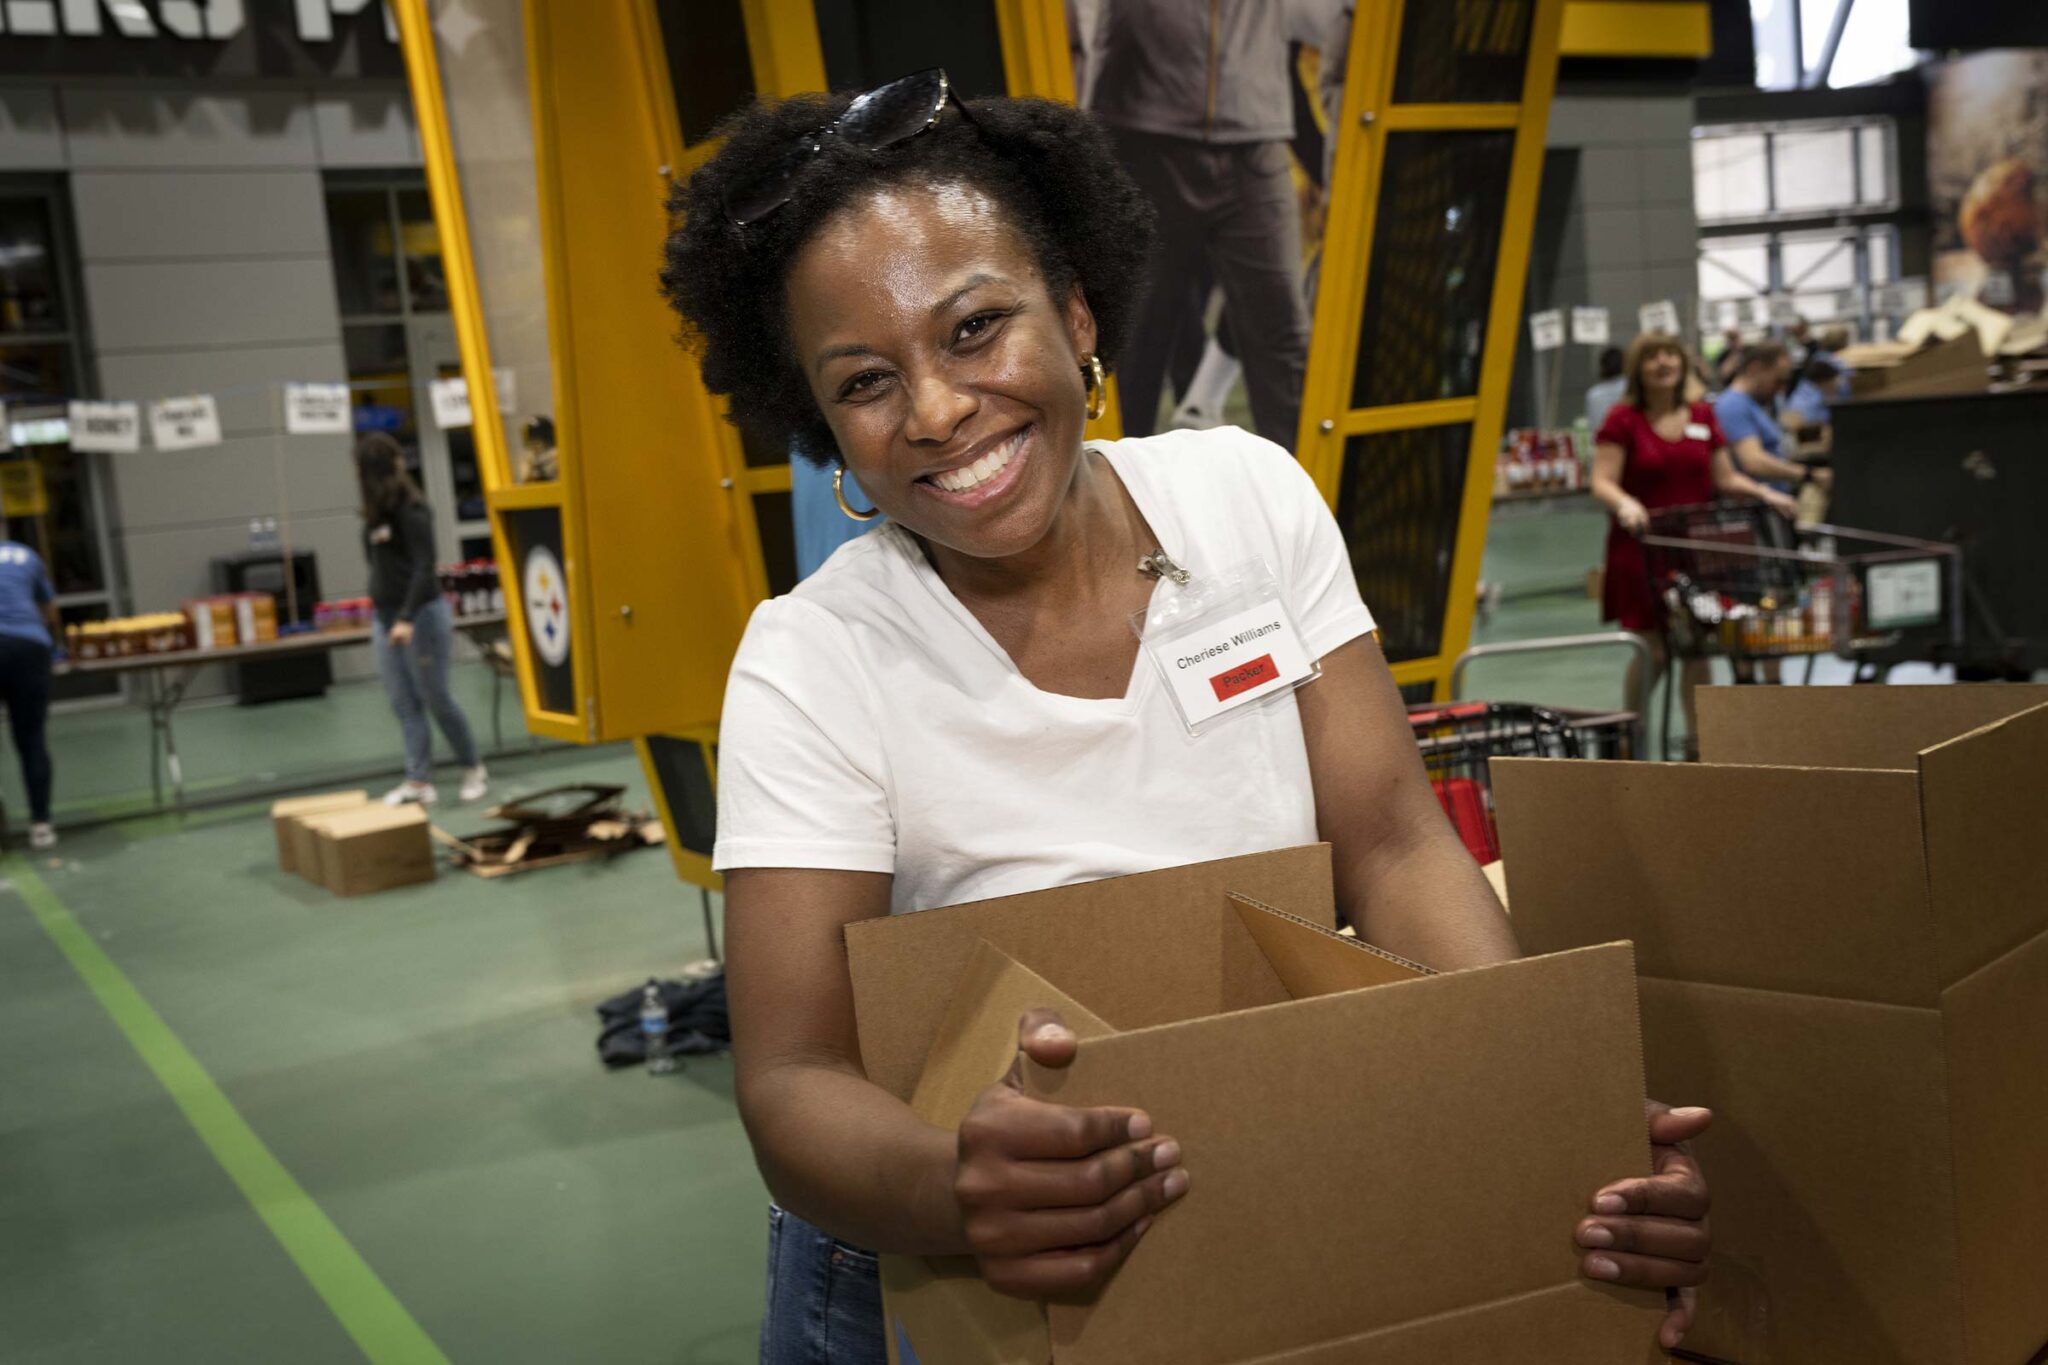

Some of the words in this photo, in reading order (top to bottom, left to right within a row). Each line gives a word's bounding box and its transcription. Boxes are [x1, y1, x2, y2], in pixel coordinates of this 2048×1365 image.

[1176, 642, 1230, 670] Cheriese
[1230, 621, 1281, 647] Williams
[1222, 663, 1264, 687] Packer
